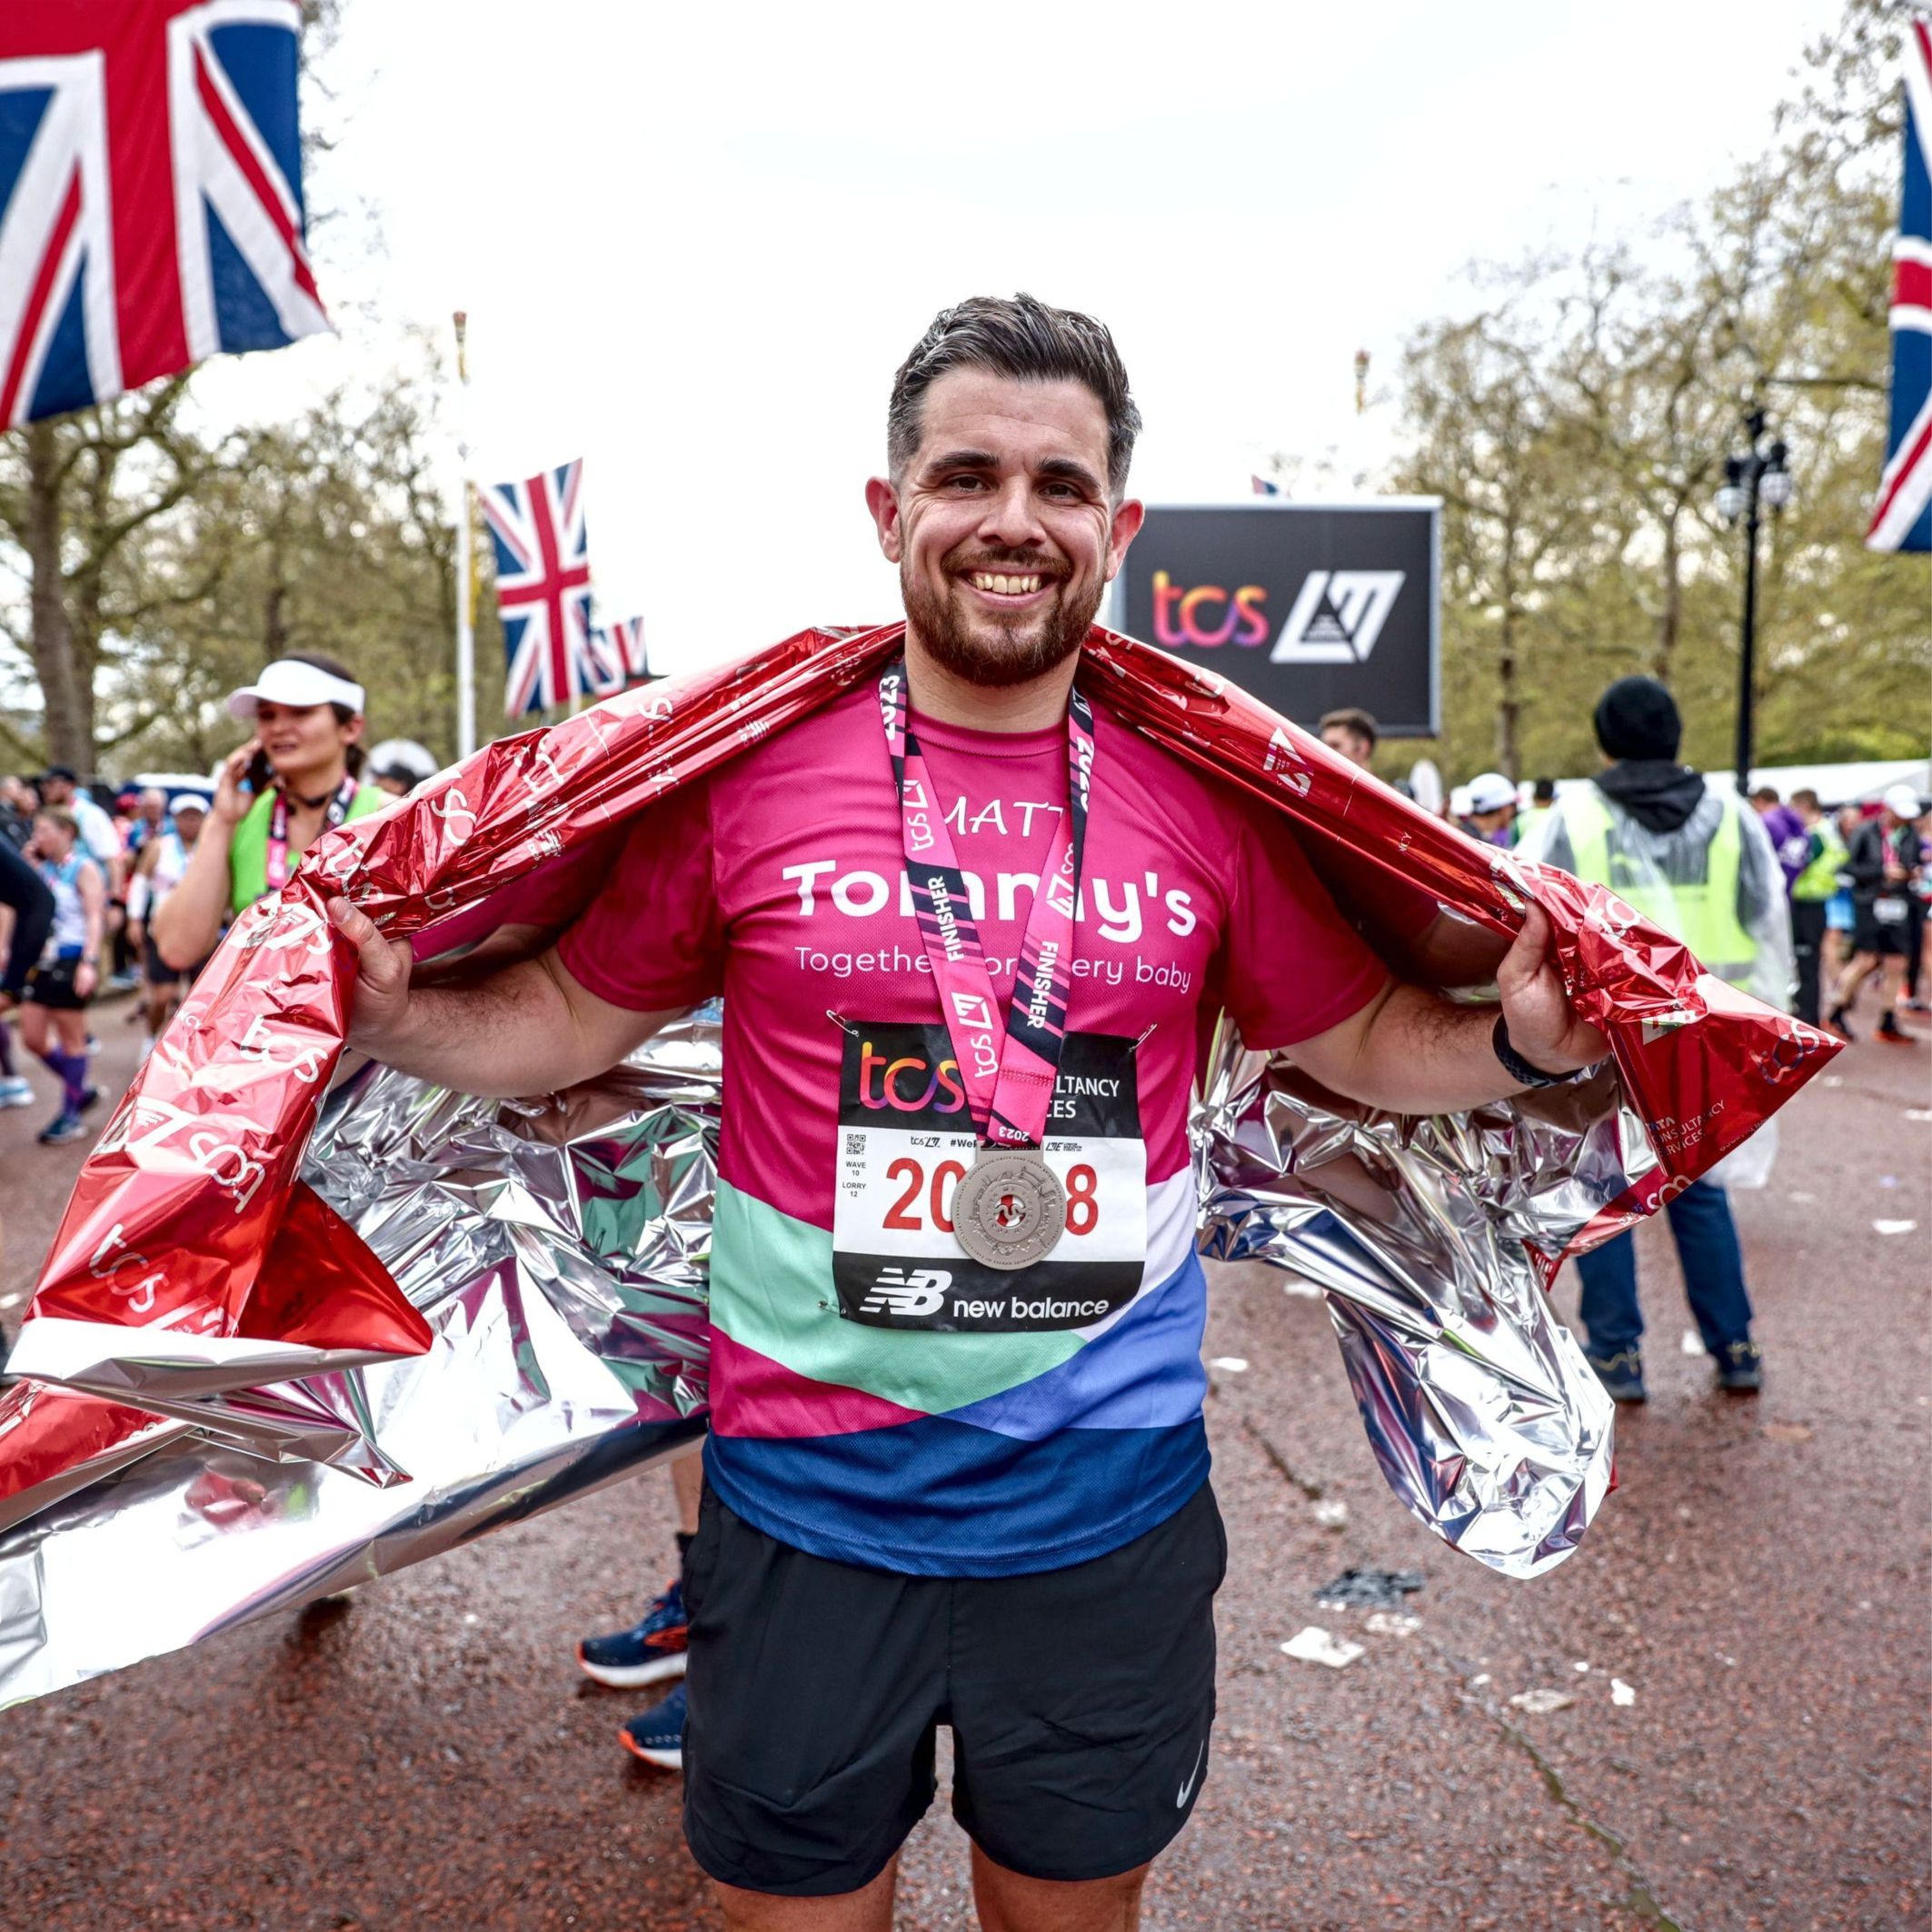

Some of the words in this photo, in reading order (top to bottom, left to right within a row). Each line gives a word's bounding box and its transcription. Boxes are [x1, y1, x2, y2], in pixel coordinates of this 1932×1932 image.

[1152, 570, 1270, 648] tcs
[928, 875, 965, 963] FINISHER
[794, 946, 931, 979] Togethe
[985, 953, 1017, 975] or
[1135, 957, 1193, 993] baby
[1027, 941, 1060, 1029] FINISHER
[859, 1041, 966, 1114] tcs
[999, 1126, 1031, 1142] 2023
[842, 1181, 867, 1190] LORRY
[845, 1160, 866, 1169] WAVE
[953, 1300, 1006, 1319] new
[1011, 1294, 1110, 1320] balance
